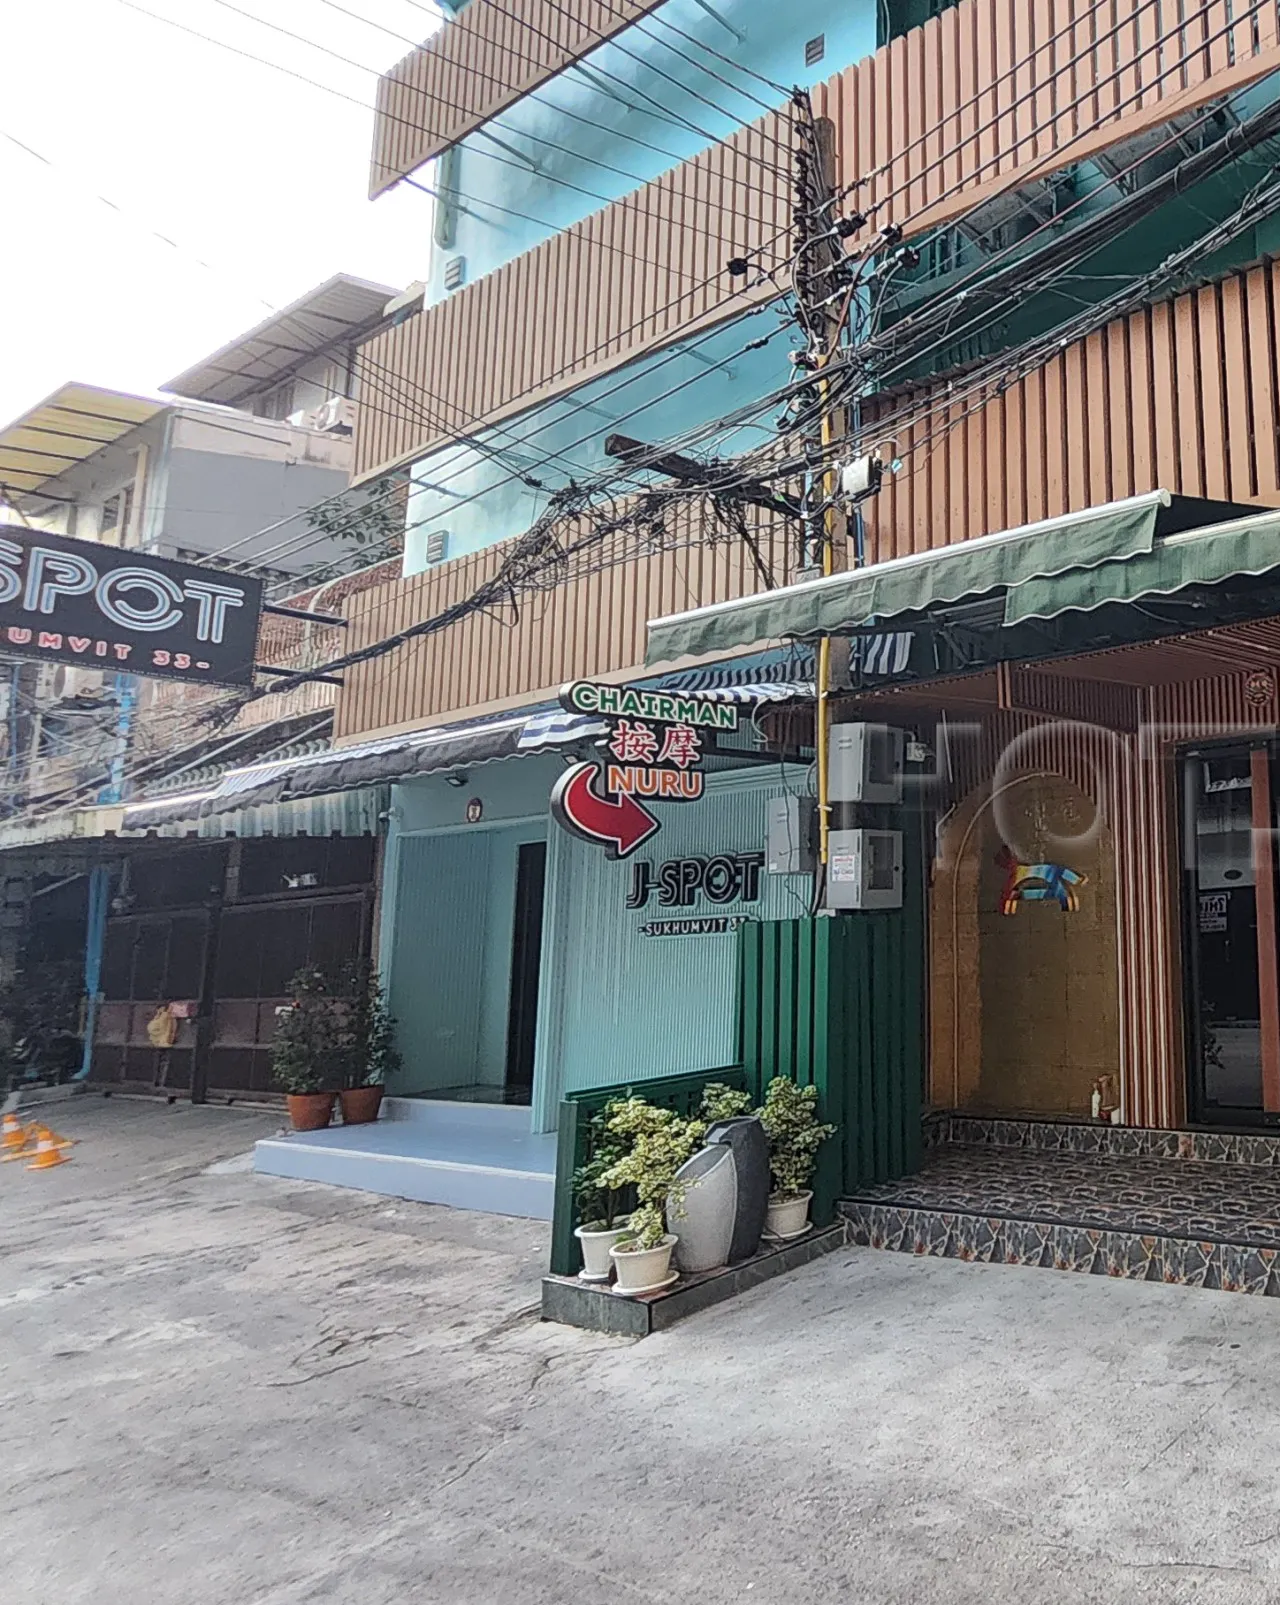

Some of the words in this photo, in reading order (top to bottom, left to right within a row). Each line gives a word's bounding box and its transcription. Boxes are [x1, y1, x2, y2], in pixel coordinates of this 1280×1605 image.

[572, 683, 737, 730] CHAIRMAN
[610, 719, 702, 767] 按摩
[608, 765, 702, 798] NURU
[626, 851, 765, 909] J-SPOT
